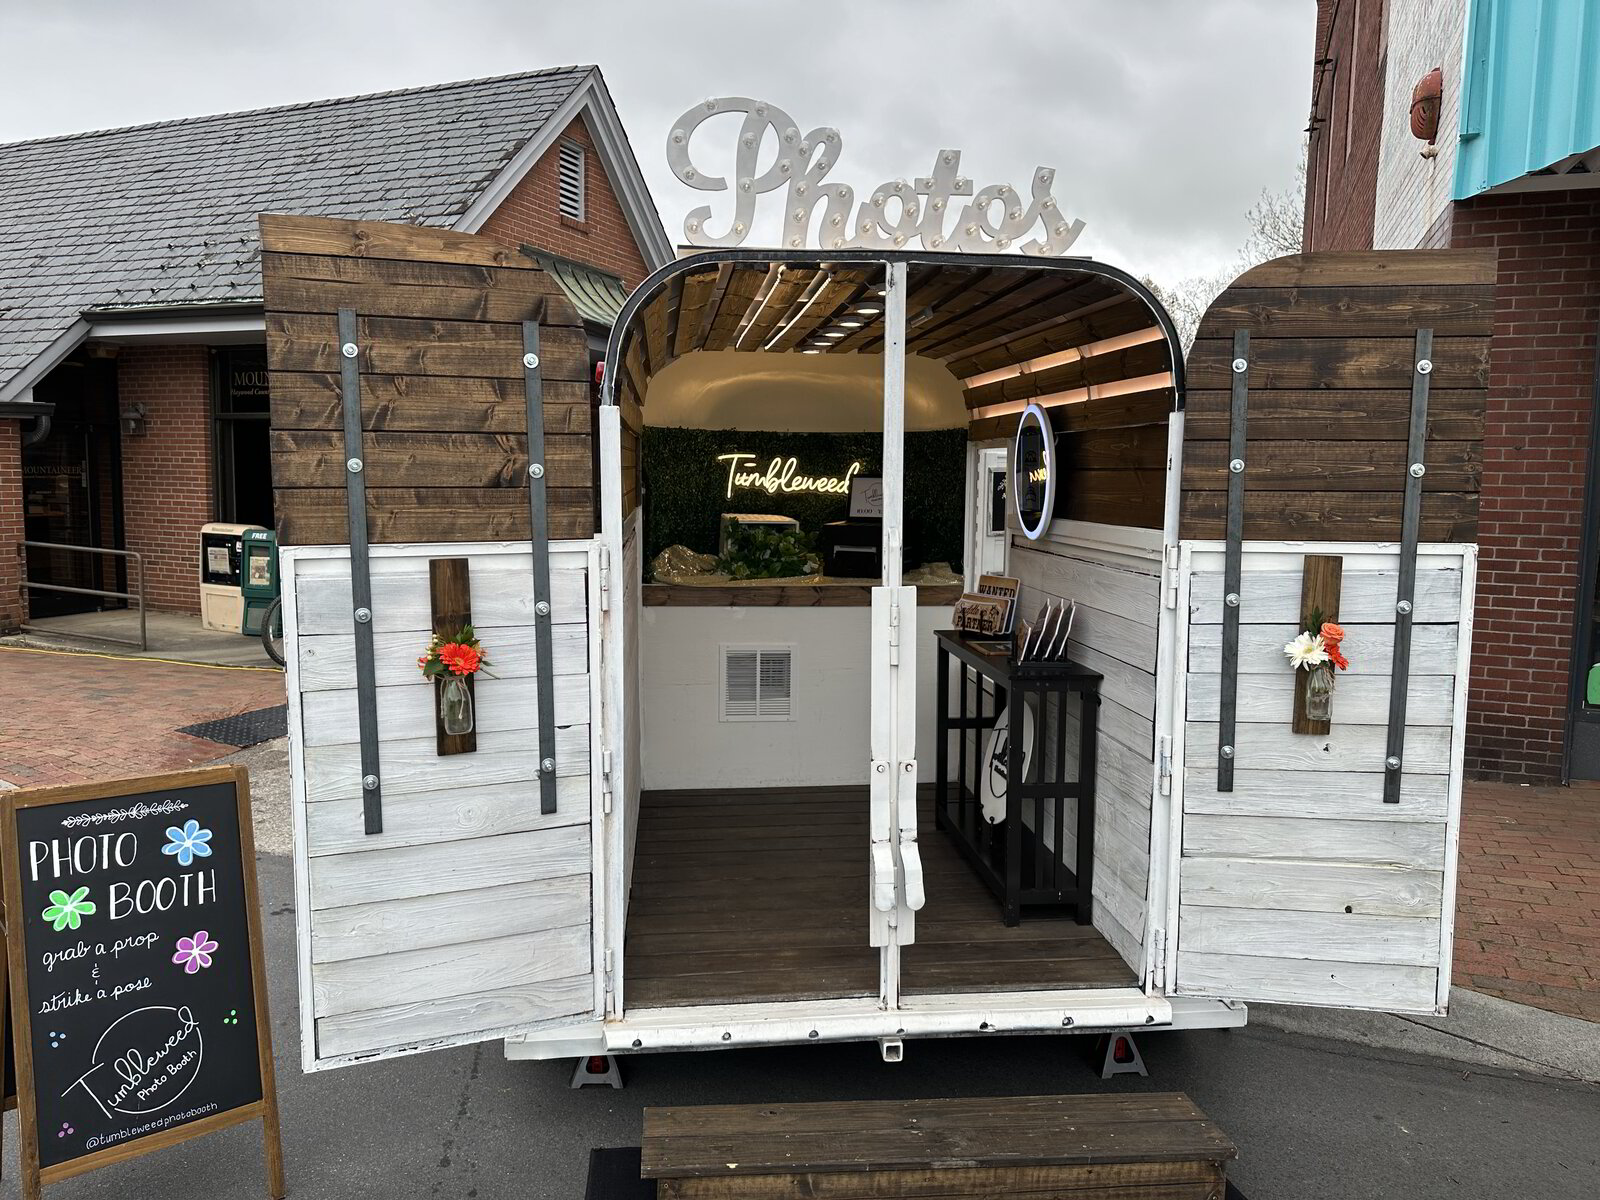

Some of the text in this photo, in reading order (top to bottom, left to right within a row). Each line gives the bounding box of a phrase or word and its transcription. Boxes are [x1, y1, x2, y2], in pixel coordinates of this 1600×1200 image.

[666, 97, 1087, 255] Photos
[718, 453, 860, 498] Tumbleweed
[251, 532, 268, 540] FREE
[979, 584, 1015, 598] WANTED
[29, 832, 138, 881] PHOTO
[109, 868, 216, 920] BOOTH
[42, 932, 160, 973] grab a prop
[38, 977, 153, 1014] strike a pose
[61, 1006, 200, 1119] Tumbleweed
[136, 1050, 198, 1101] Photo Booth
[86, 1101, 218, 1150] @tumbleweedphotobooth
